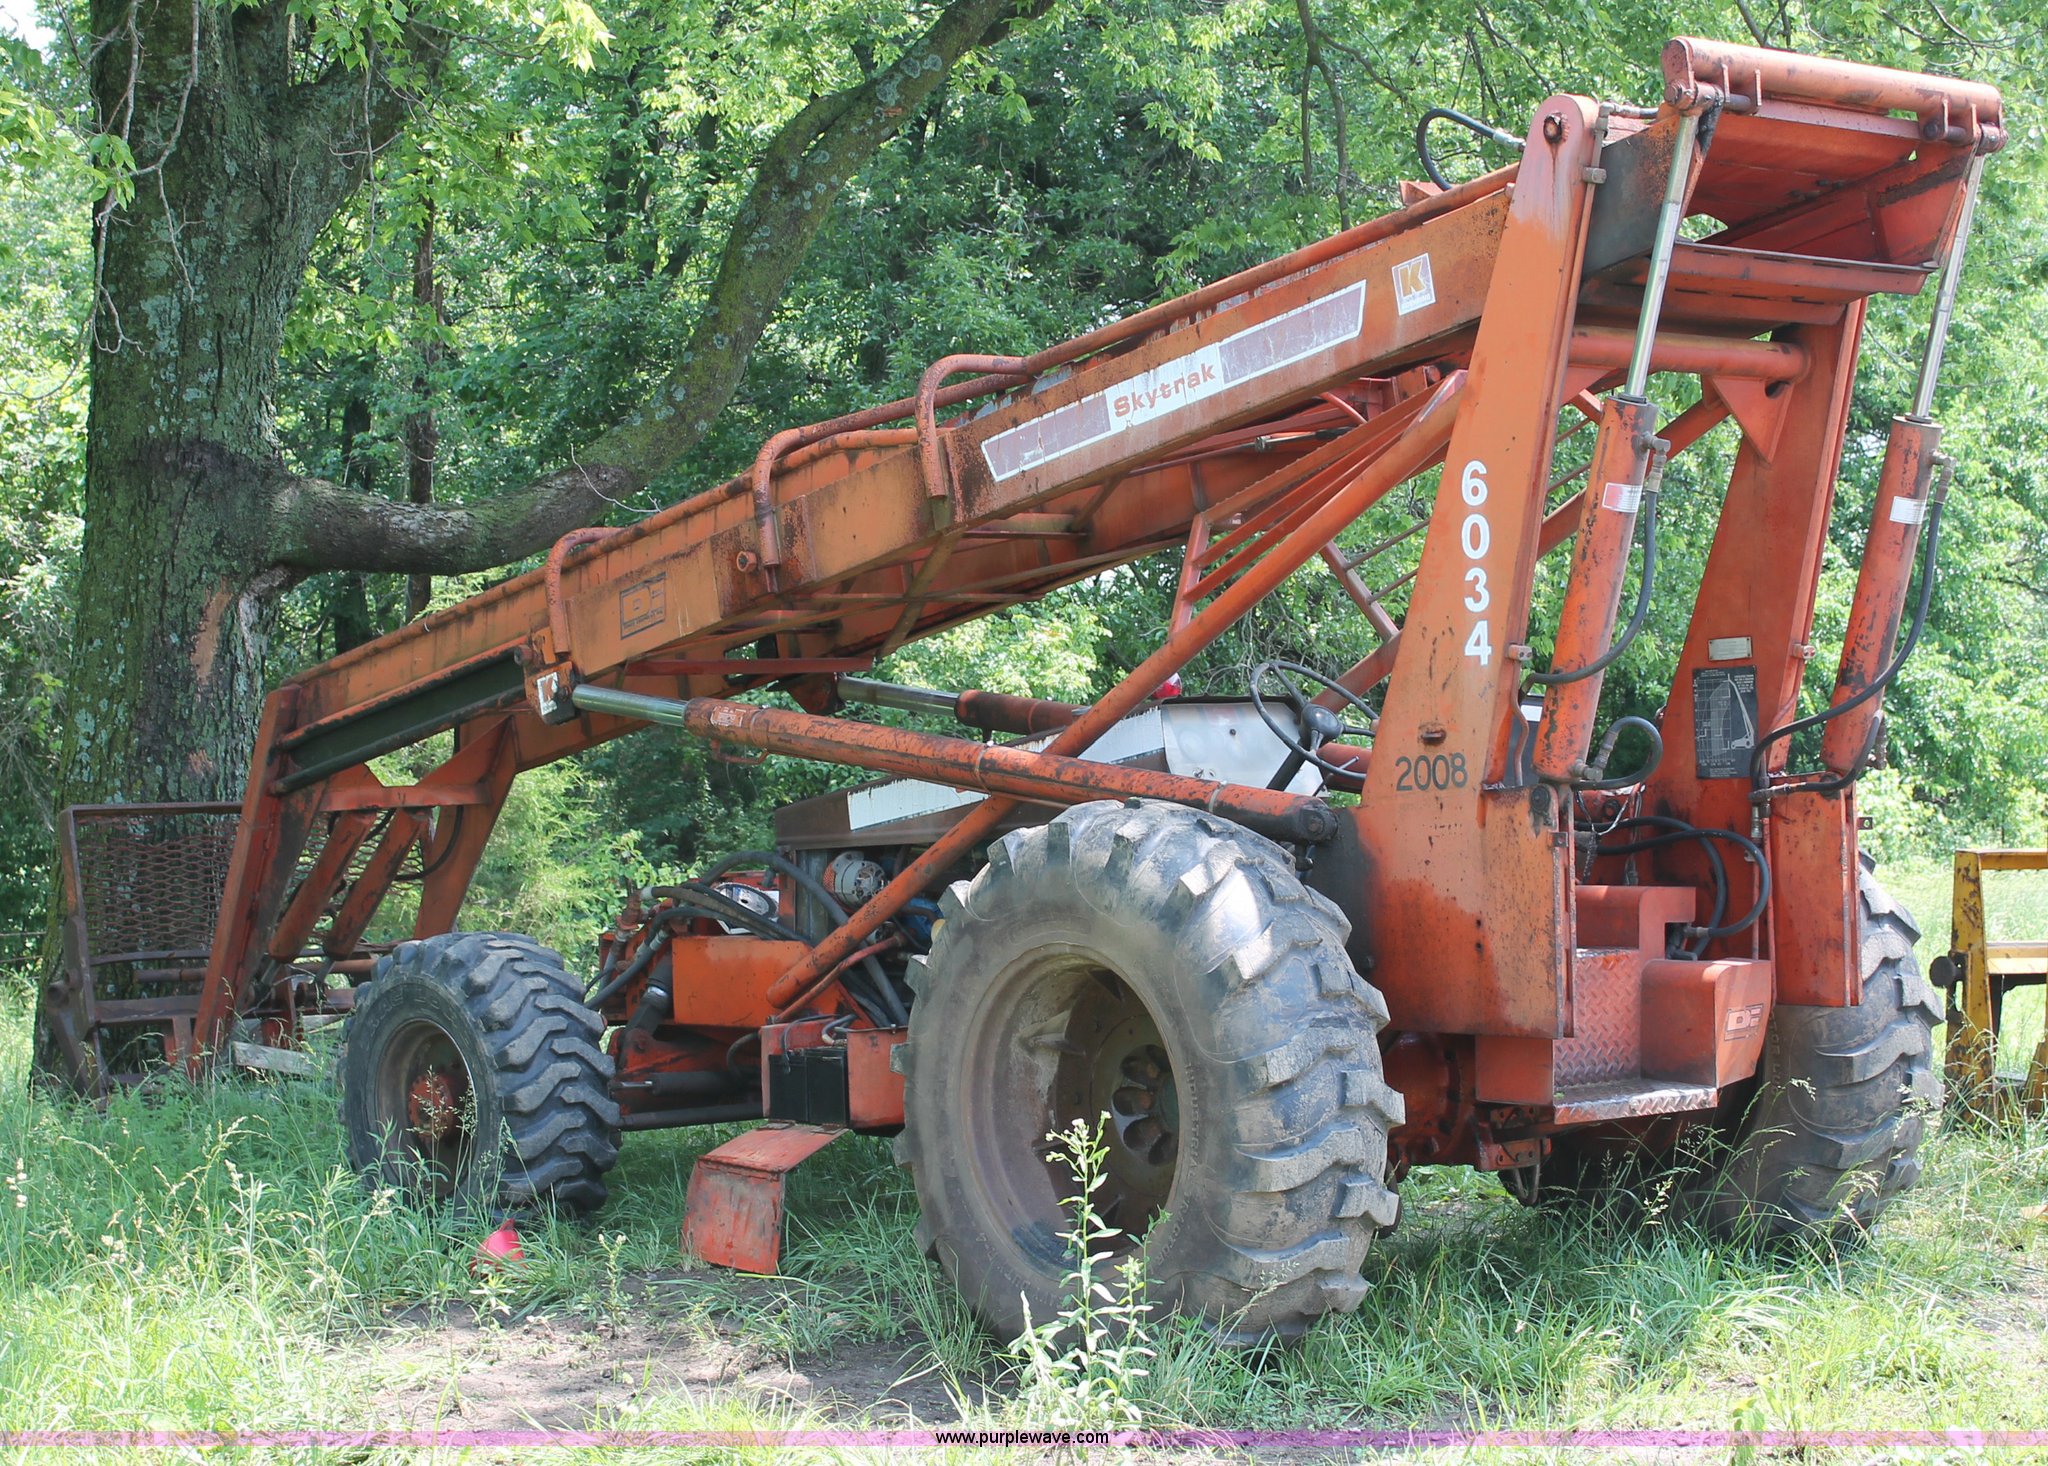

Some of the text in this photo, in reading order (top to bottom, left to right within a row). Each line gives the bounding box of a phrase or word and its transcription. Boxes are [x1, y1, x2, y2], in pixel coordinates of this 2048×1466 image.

[1398, 261, 1426, 298] K
[1113, 362, 1216, 418] Skytrak
[1461, 460, 1492, 667] 6034
[1395, 752, 1468, 791] 2008
